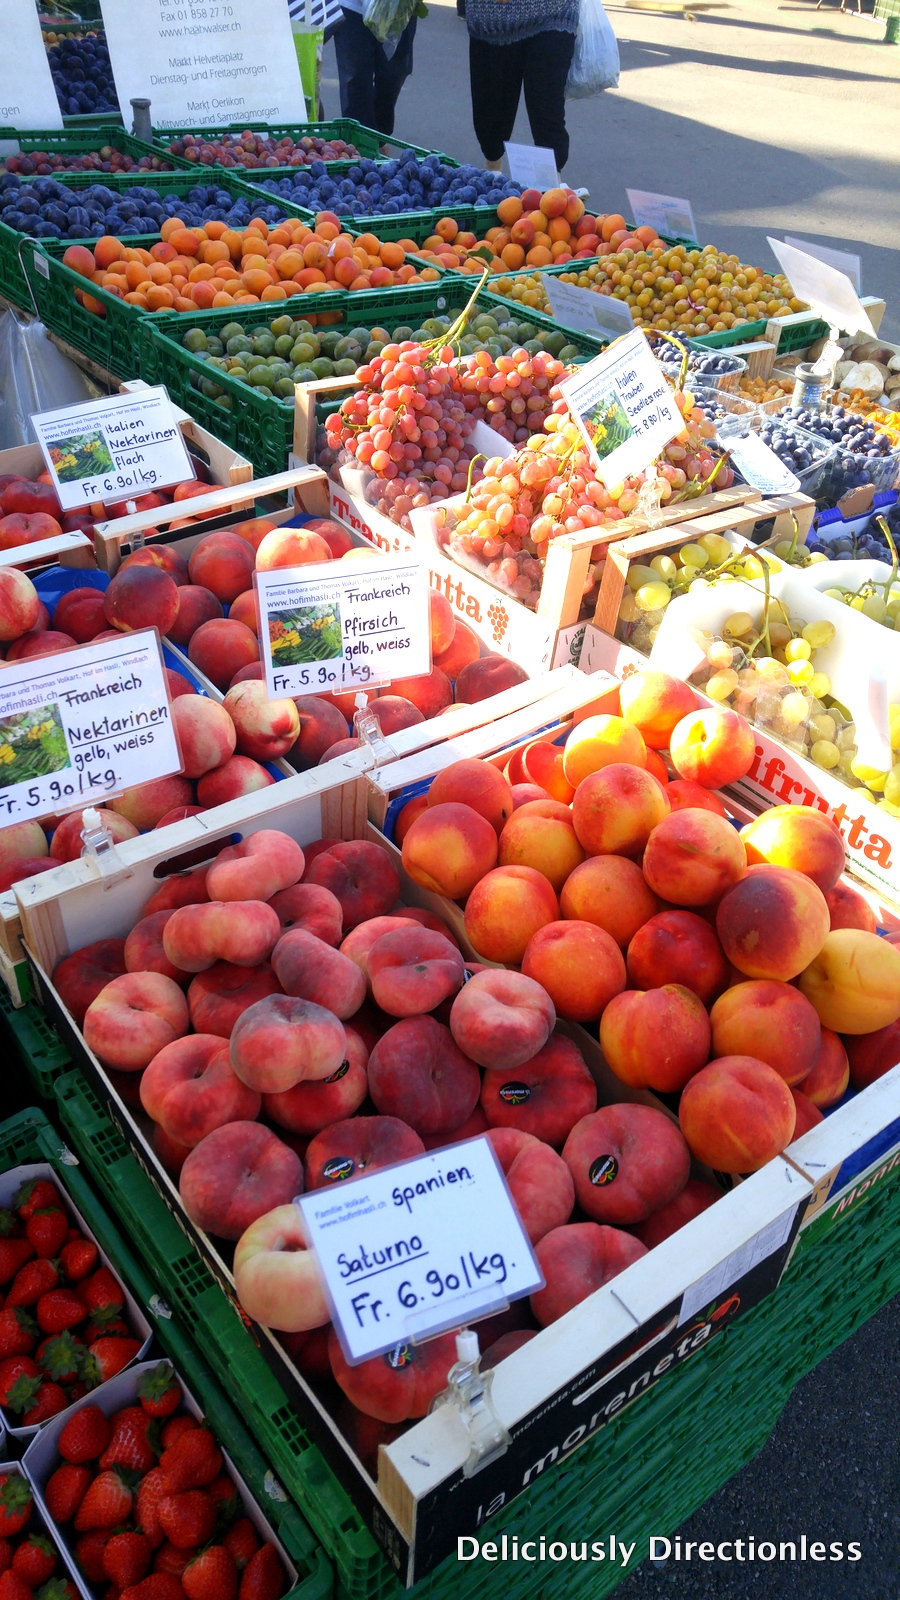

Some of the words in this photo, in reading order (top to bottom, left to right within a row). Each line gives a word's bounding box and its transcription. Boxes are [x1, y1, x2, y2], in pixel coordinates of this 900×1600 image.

[160, 12, 175, 21] Fax
[178, 10, 188, 20] 01
[191, 9, 208, 19] 858
[211, 7, 219, 17] 27
[222, 6, 233, 16] 70
[169, 57, 192, 67] Markt
[194, 52, 244, 65] Helvetiaplatz
[150, 74, 189, 85] Dienstag-
[191, 71, 208, 81] und
[209, 64, 267, 79] Freitagmorgen
[0, 106, 20, 118] gen
[187, 101, 210, 111] Markt
[211, 97, 245, 109] Oerlikon
[156, 116, 197, 129] Mittwoch-
[199, 114, 215, 124] und
[217, 107, 279, 122] Samstagmorgen
[615, 370, 638, 389] Italien
[620, 382, 645, 402] Trauben
[627, 394, 654, 417] Seedless
[43, 421, 102, 440] www.hofimhasli.ch
[105, 418, 145, 434] Italien
[109, 427, 177, 450] Nektarinen
[82, 482, 101, 497] Fr.
[265, 589, 286, 597] Familie
[287, 587, 308, 595] Barbara
[309, 584, 319, 592] und
[320, 582, 340, 590] Thomas
[267, 591, 341, 608] www.hofimhasli.ch
[344, 582, 411, 603] Frankreich
[345, 640, 374, 660] gelb,
[376, 636, 411, 650] weiss
[18, 686, 30, 695] und
[31, 681, 56, 691] Thomas
[82, 668, 94, 678] Hof
[95, 666, 104, 674] im
[122, 655, 149, 666] Windlach
[58, 672, 142, 707] Frankreich
[0, 690, 58, 713] ofimhasli.ch
[67, 705, 168, 744] Nektarinen
[74, 746, 110, 772] gelb,
[113, 731, 154, 754] weiss
[745, 746, 893, 870] ifrutta
[391, 1166, 472, 1214] Spanien
[314, 1205, 343, 1220] Familie
[343, 1195, 370, 1208] Volkart
[337, 1235, 423, 1278] Saturno
[351, 1292, 390, 1327] Fr.
[476, 1491, 506, 1527] la
[522, 1323, 712, 1487] moreneta
